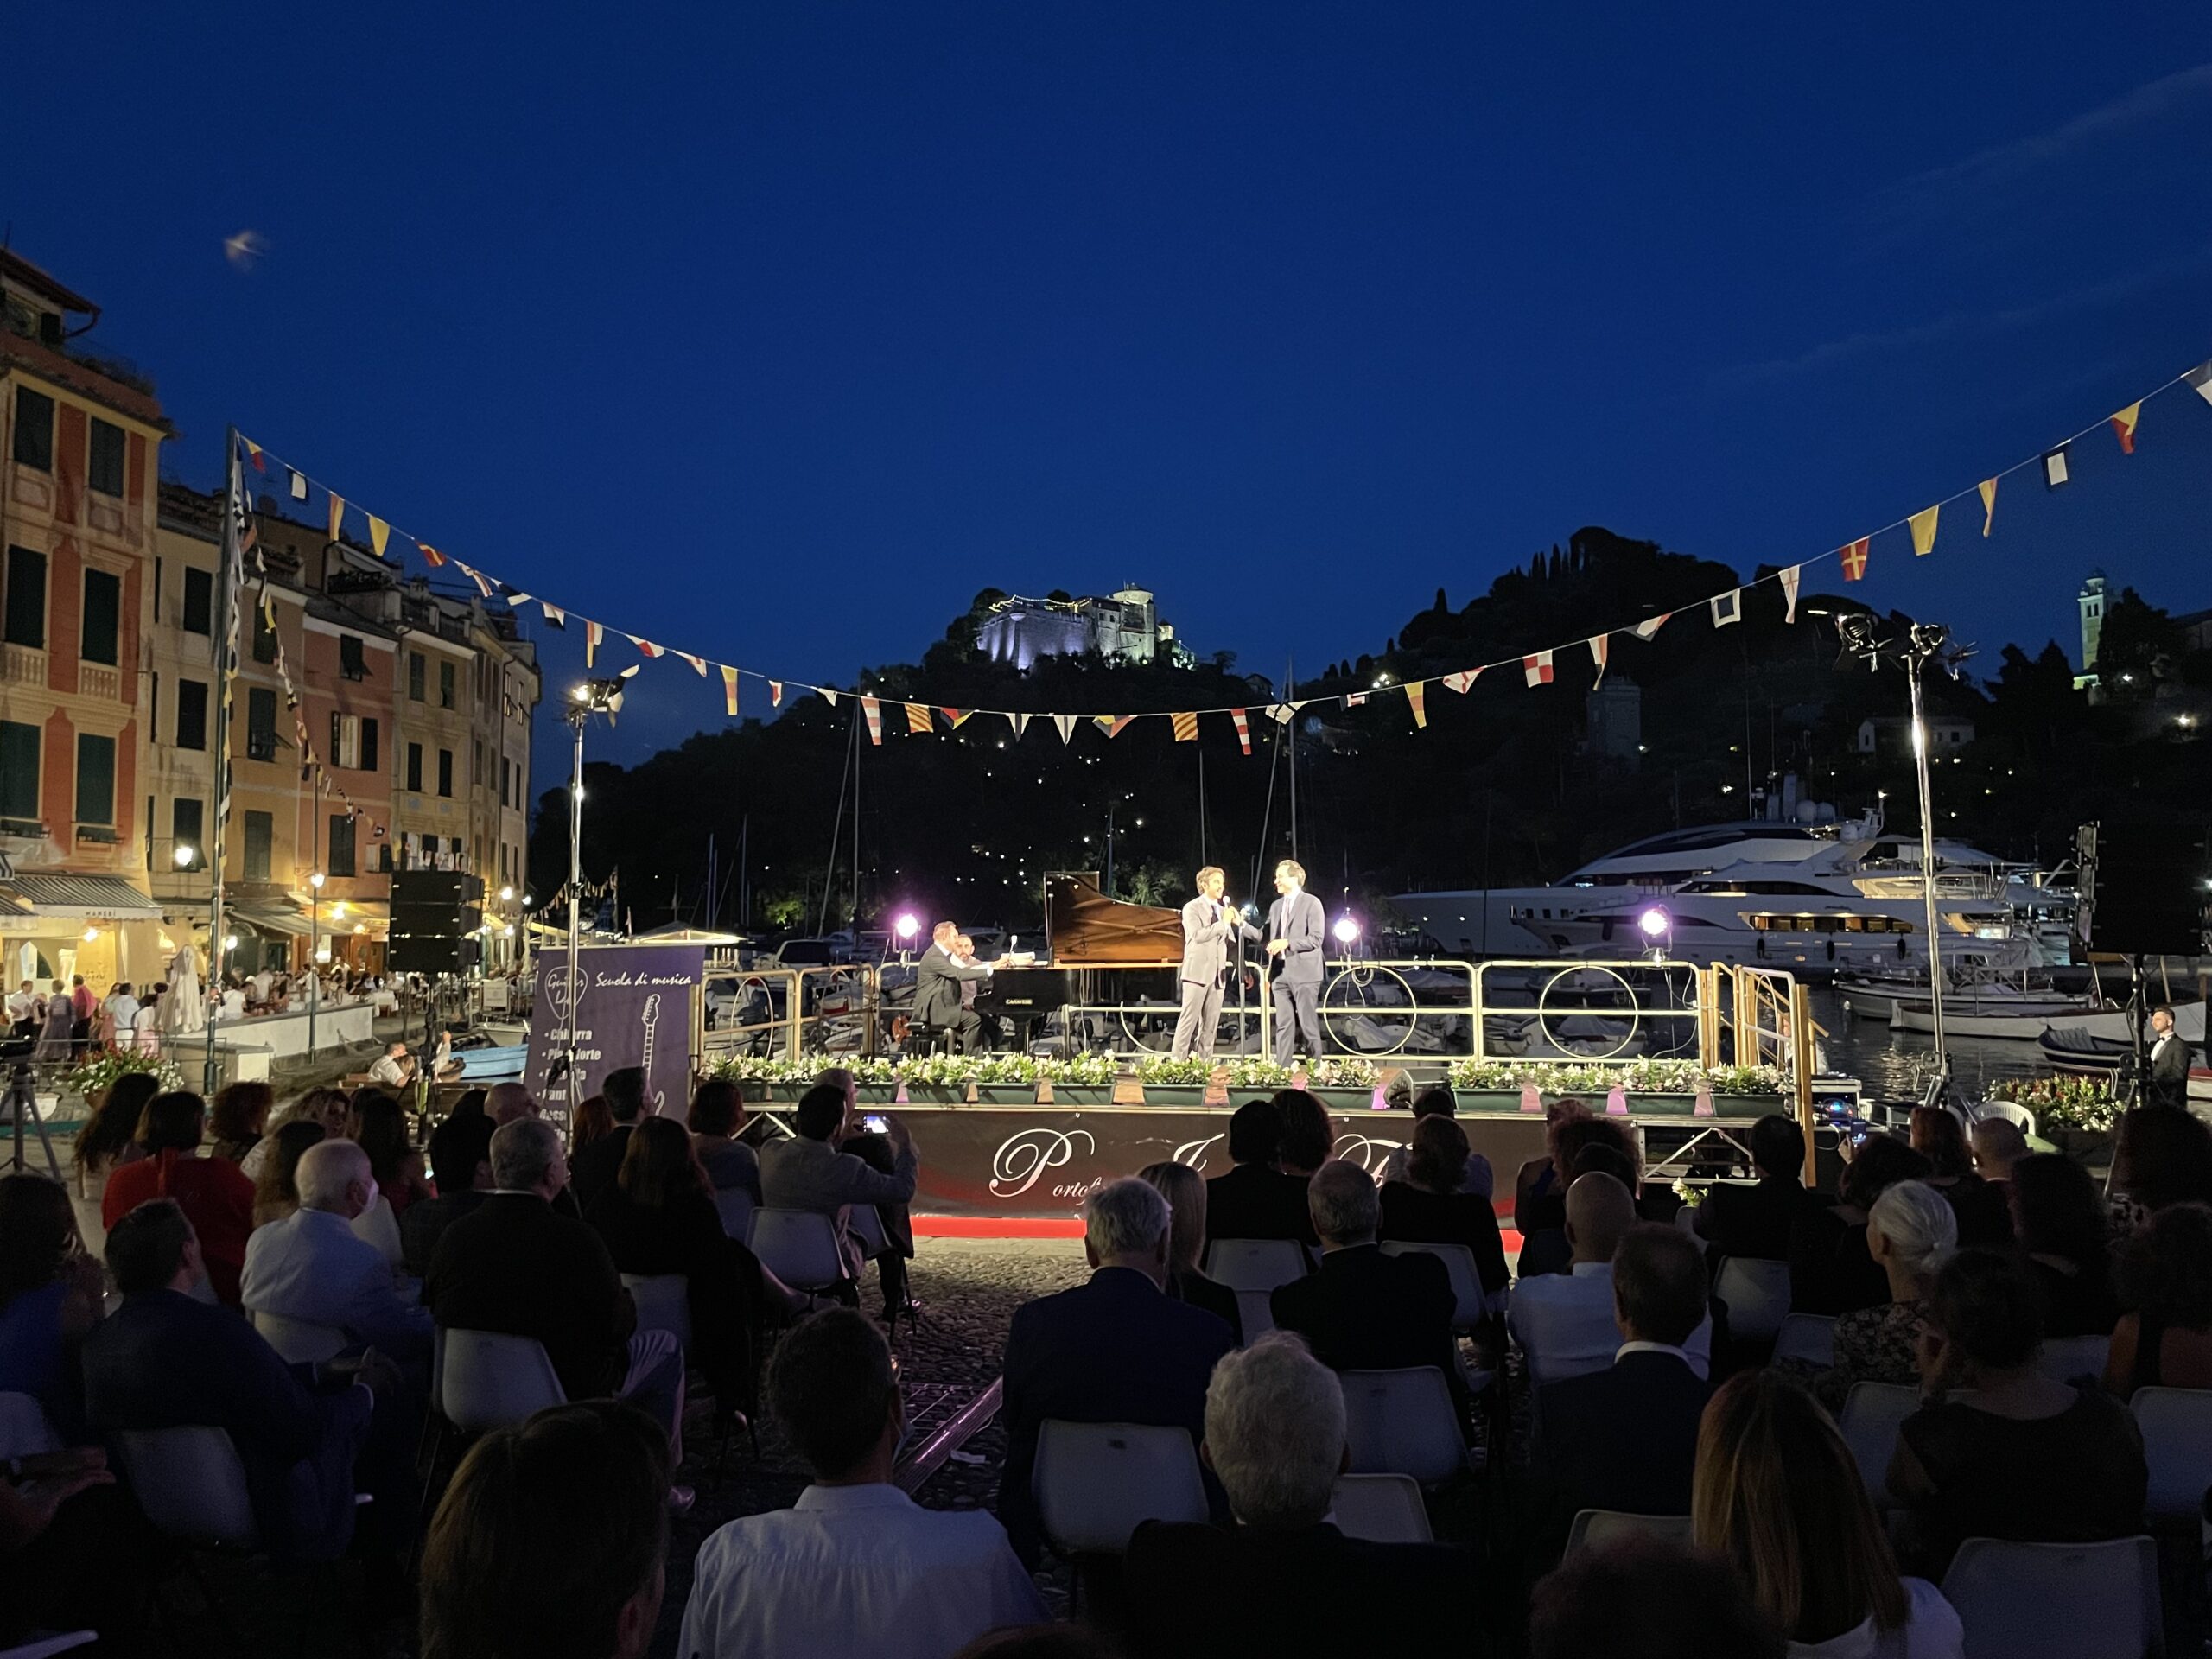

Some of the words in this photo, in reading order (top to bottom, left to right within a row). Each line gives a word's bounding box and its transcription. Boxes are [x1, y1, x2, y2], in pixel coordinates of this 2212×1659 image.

[595, 971, 632, 987] Scuola
[634, 972, 648, 987] di
[651, 972, 692, 986] musica
[547, 1048, 601, 1061] Piaforte
